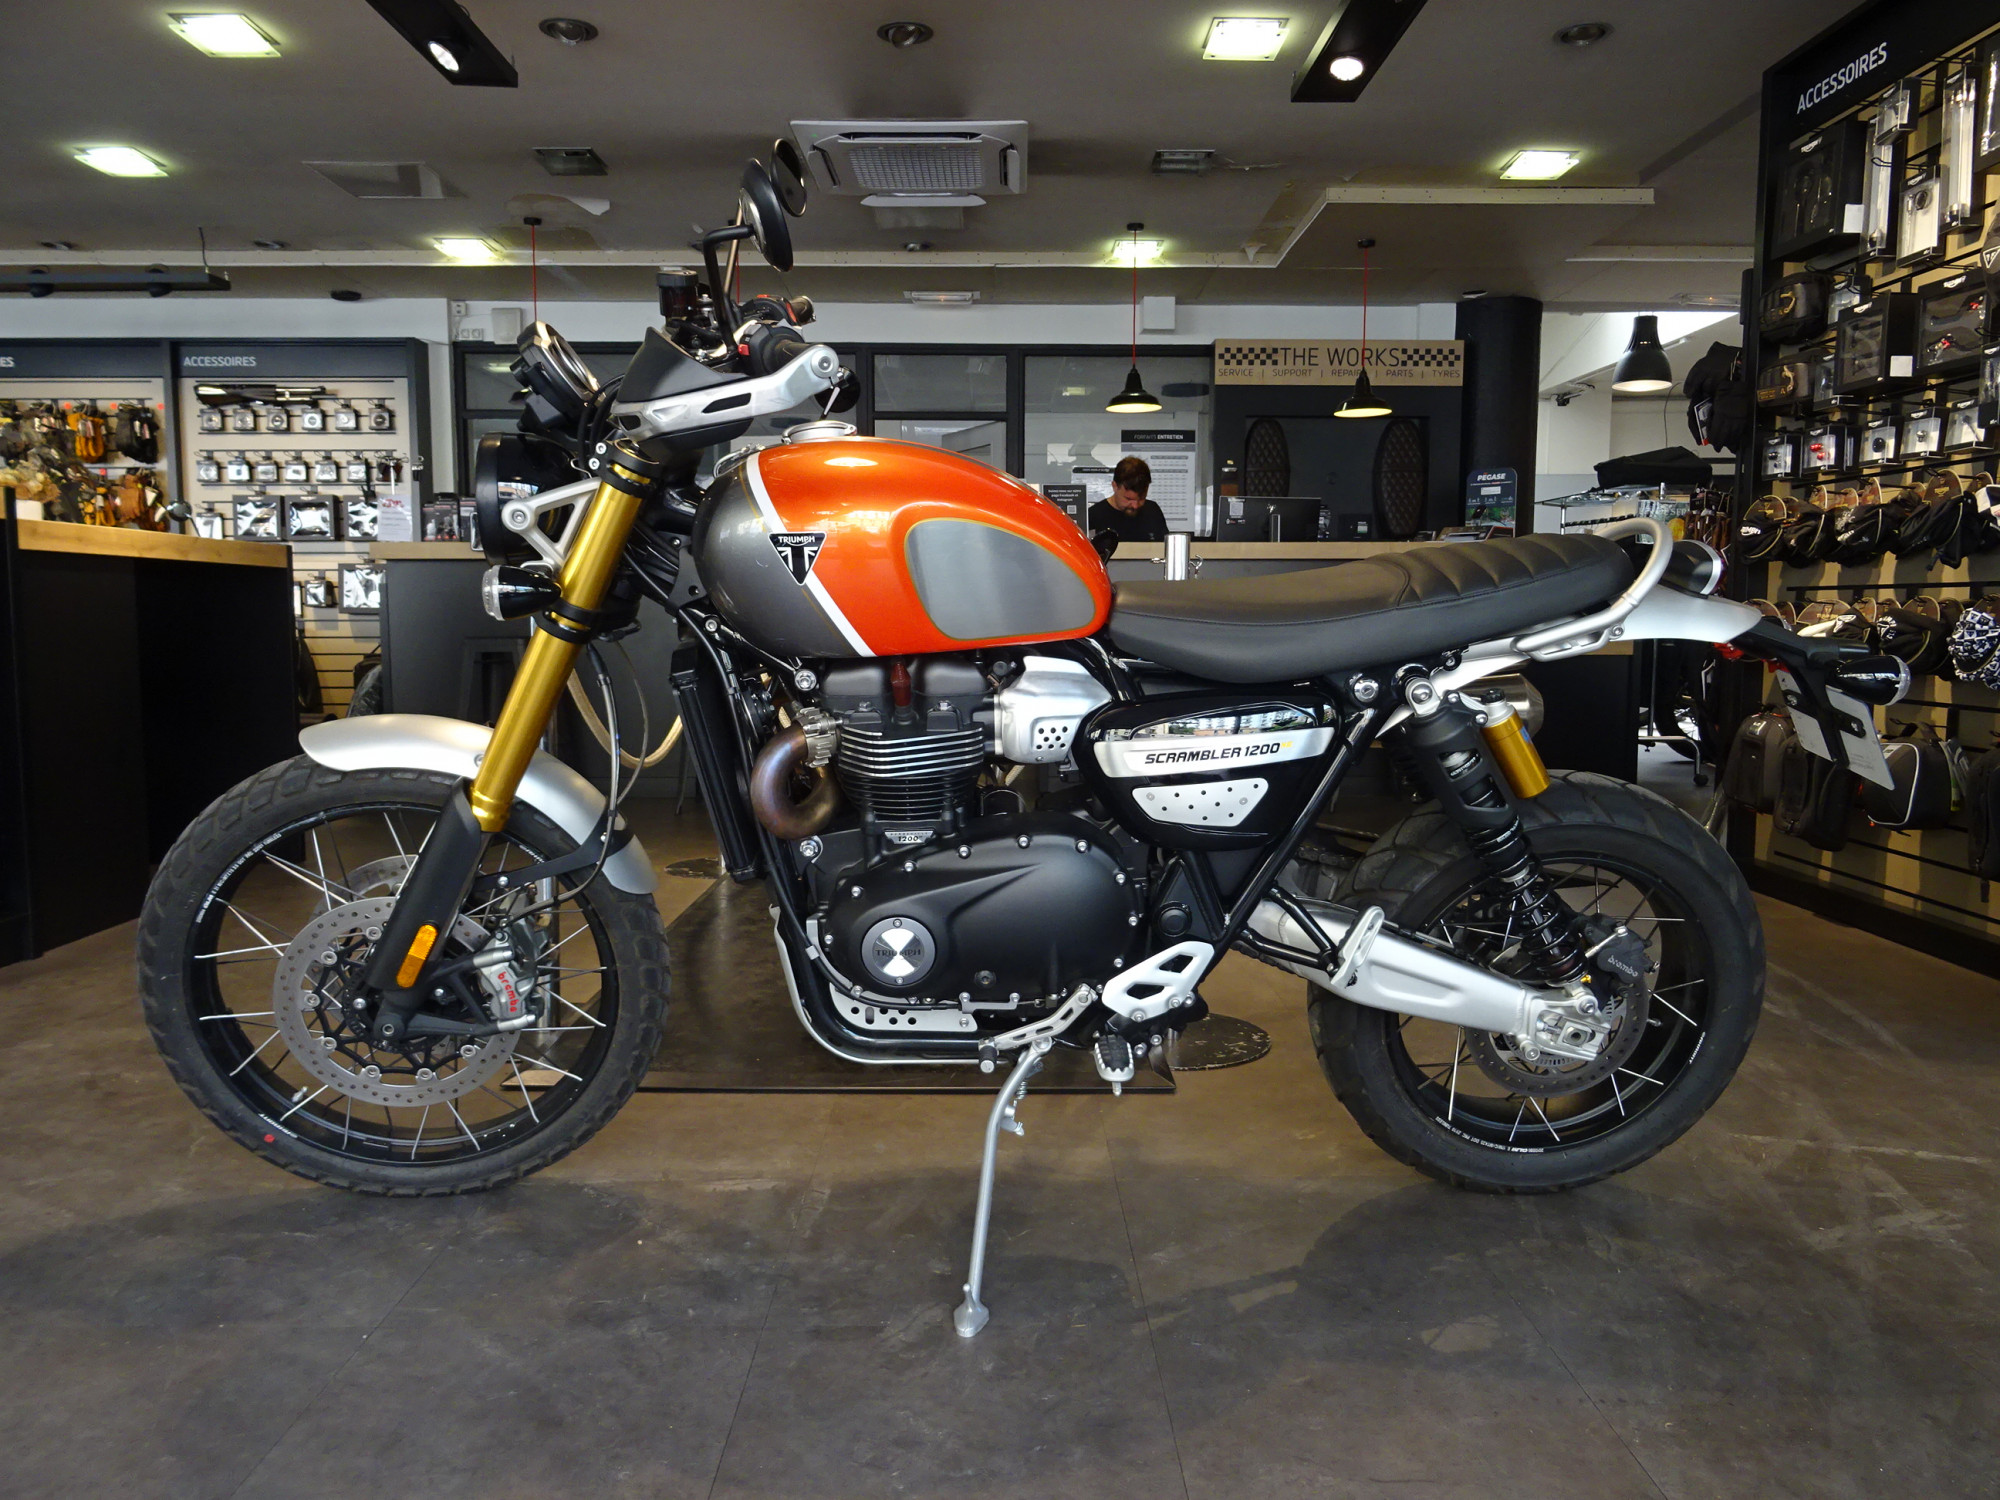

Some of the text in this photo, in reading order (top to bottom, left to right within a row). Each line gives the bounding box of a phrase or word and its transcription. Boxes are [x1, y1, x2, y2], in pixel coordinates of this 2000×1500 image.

[1797, 42, 1887, 115] ACCESSOIRES
[183, 356, 256, 367] ACCESSOIRES
[1280, 347, 1400, 367] THE WORKS
[1218, 368, 1254, 377] SERVICE
[1272, 368, 1312, 377] SUPPORT
[1386, 369, 1414, 378] PARTS
[1432, 369, 1461, 378] TYRES
[778, 535, 816, 546] TRIUMPH
[1144, 747, 1242, 764] SCRAMBLER
[1244, 742, 1281, 756] 1200
[1607, 954, 1639, 977] brembo
[497, 971, 518, 1013] brembo
